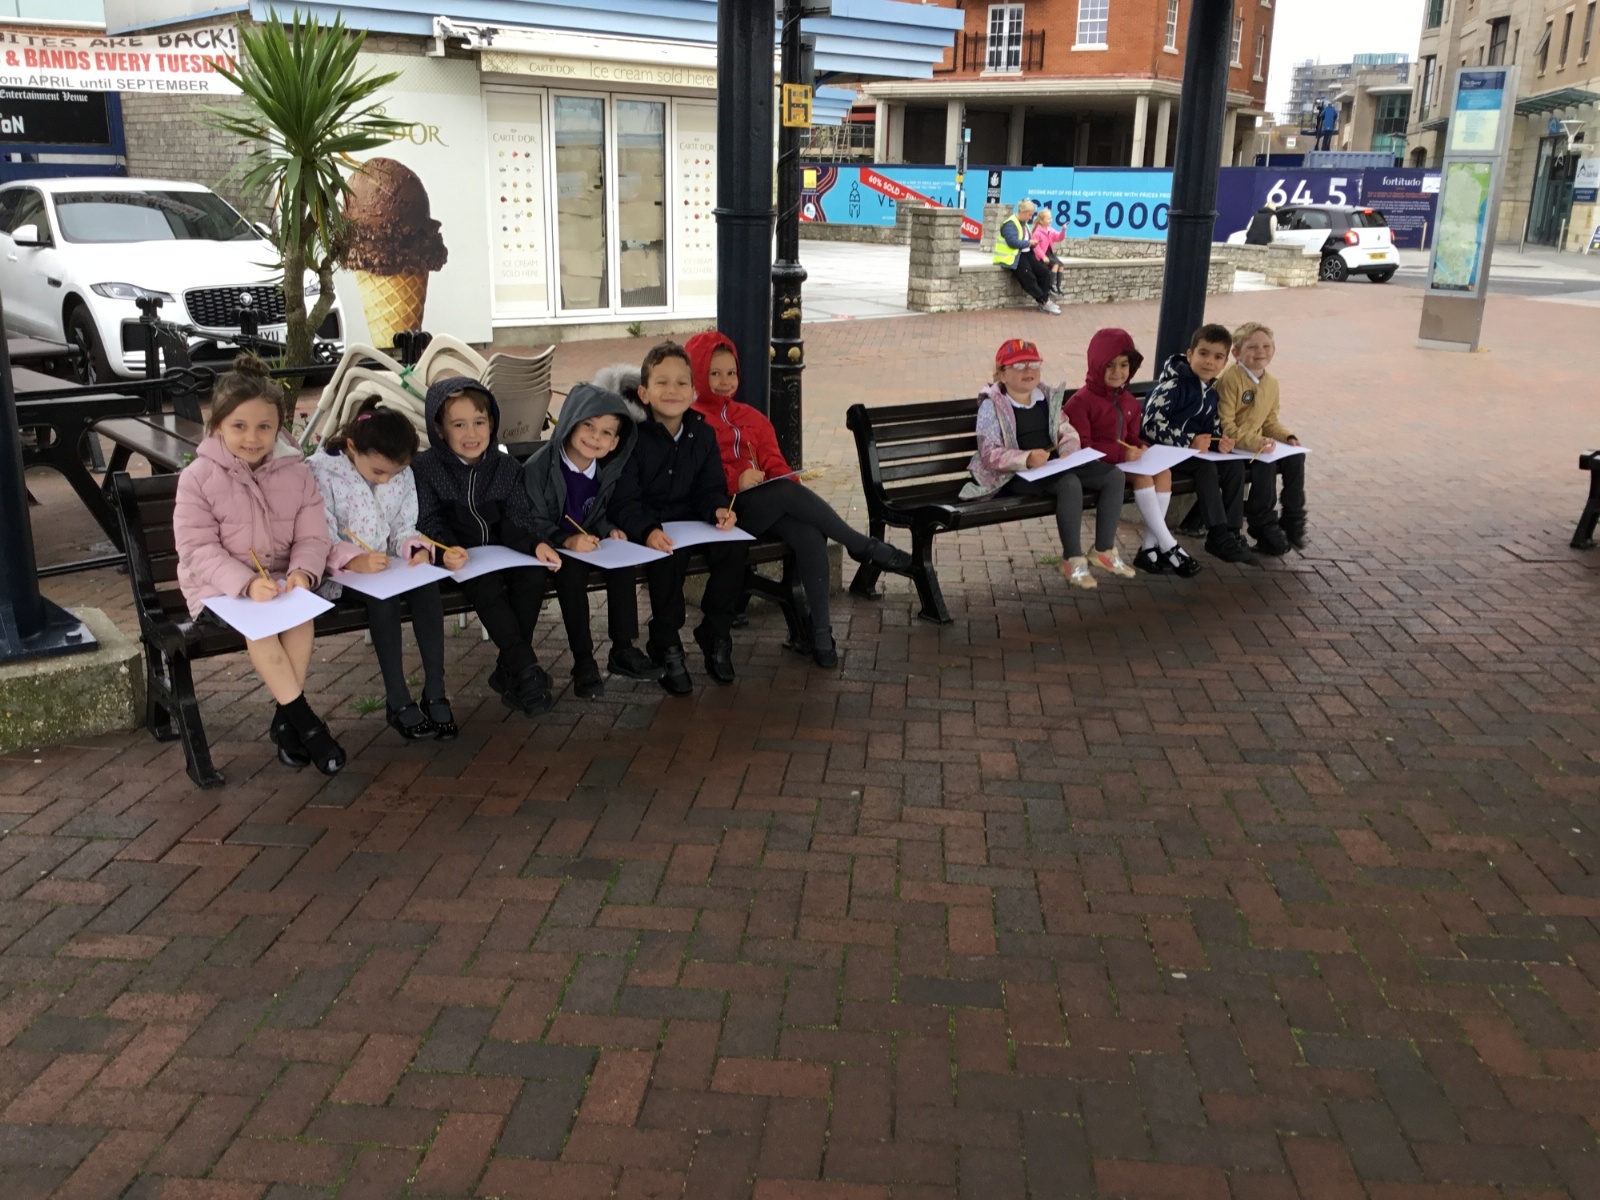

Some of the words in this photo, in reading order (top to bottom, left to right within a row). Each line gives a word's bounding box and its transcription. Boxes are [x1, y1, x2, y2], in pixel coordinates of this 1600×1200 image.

[89, 37, 143, 48] ARE
[157, 28, 237, 50] BACK!
[5, 50, 20, 67] &
[23, 47, 91, 71] BANDS
[94, 52, 151, 72] EVERY
[28, 75, 75, 88] APRIL
[80, 78, 112, 89] until
[116, 78, 209, 91] SEPTEMBER
[529, 62, 554, 73] CARTE
[589, 61, 609, 79] Ice
[613, 67, 653, 81] cream
[657, 67, 683, 83] sold
[687, 68, 715, 86] here
[0, 89, 60, 101] Entertainment
[62, 91, 88, 102] Venue
[868, 174, 883, 188] 60%
[883, 181, 900, 196] SOLD
[1382, 175, 1421, 187] fortitudo
